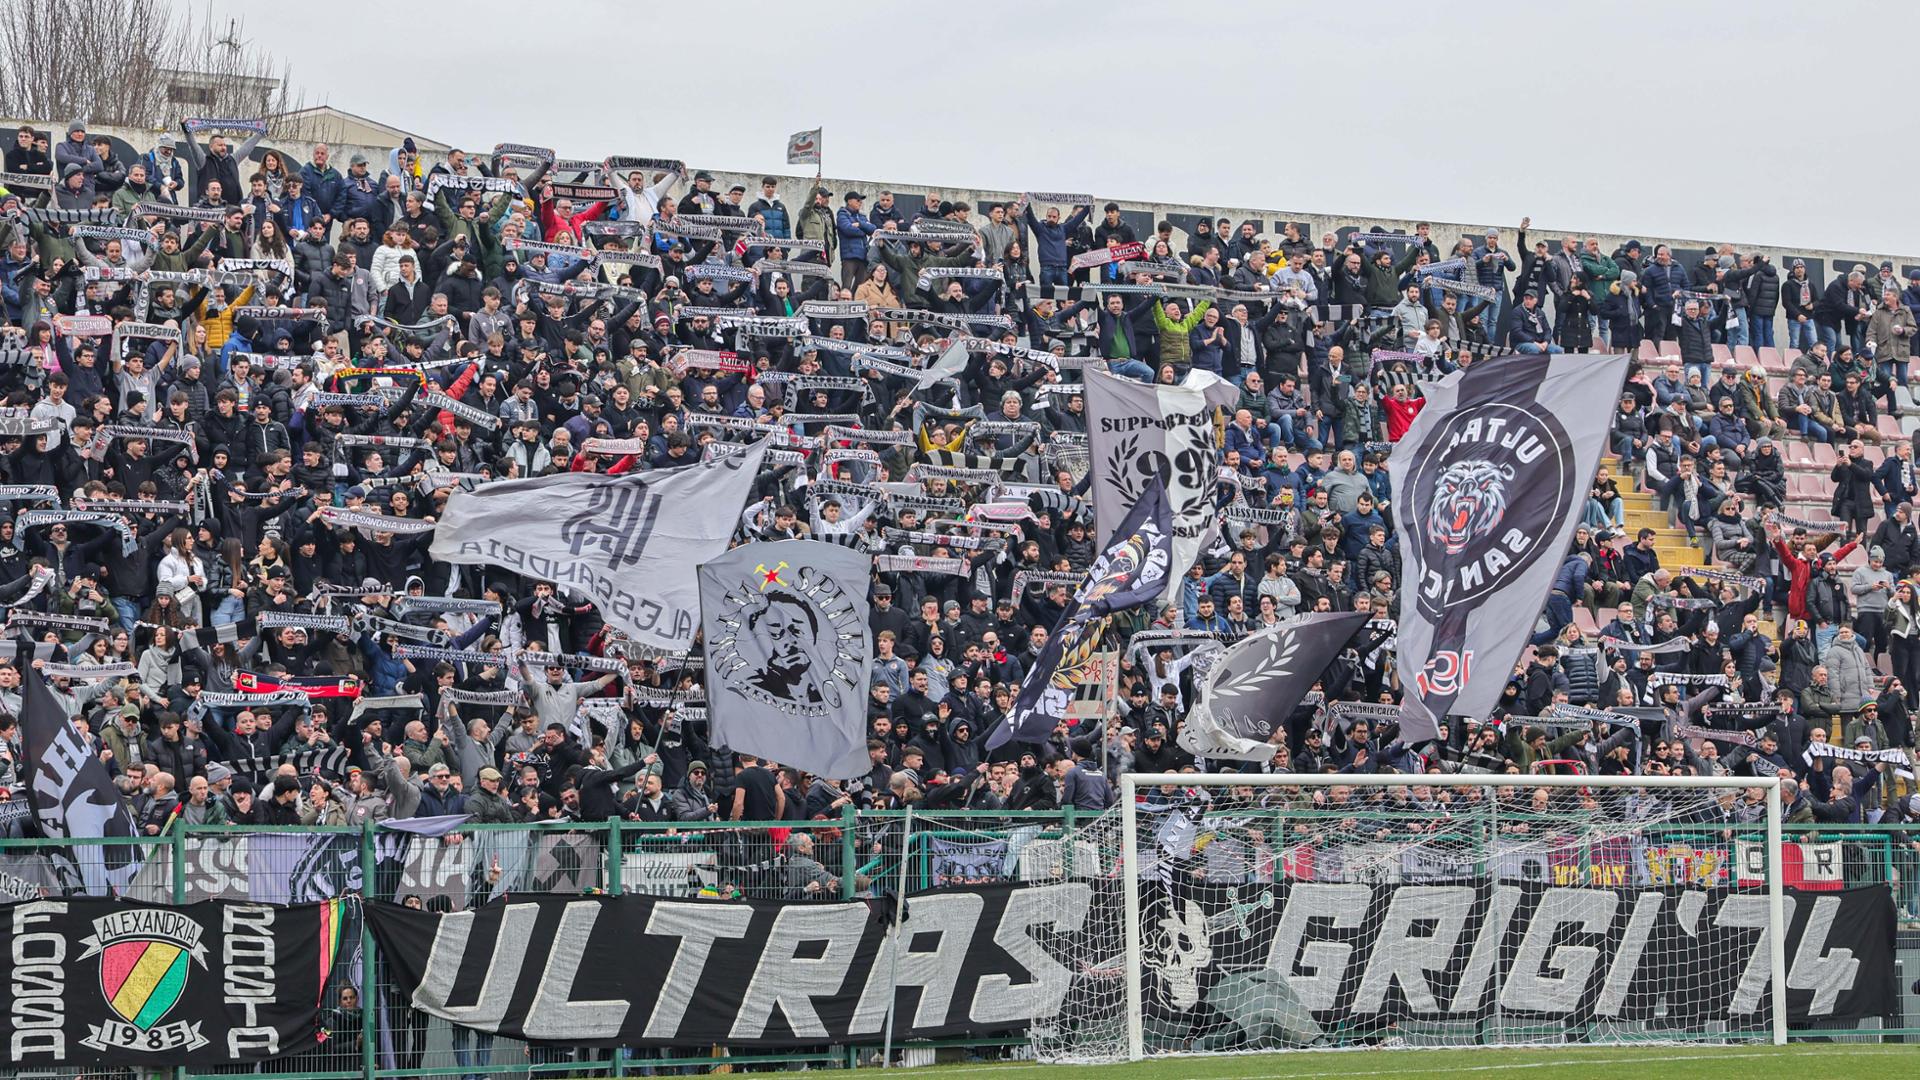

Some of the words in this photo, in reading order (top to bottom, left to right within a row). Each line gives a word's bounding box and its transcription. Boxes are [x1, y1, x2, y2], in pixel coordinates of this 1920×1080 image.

[619, 158, 655, 170] ALESSANDRIA
[23, 174, 52, 188] LTRAS
[554, 186, 574, 197] FORZA
[575, 188, 616, 199] ALESSANDRIA
[82, 225, 116, 236] FORZA
[119, 229, 148, 240] GRIGI
[1113, 246, 1143, 256] MILAN
[699, 266, 728, 276] FORZA
[119, 322, 152, 336] ULTRAS
[816, 338, 848, 351] viaggio
[319, 394, 353, 403] FORZA
[22, 510, 64, 526] viaggio
[340, 511, 403, 529] ALESSANDRIA
[1225, 507, 1288, 522] ALESSANDRIA
[516, 651, 556, 664] ORZA
[203, 692, 249, 706] viaggio
[1332, 703, 1375, 717] ALESSANDRIA
[1814, 848, 1834, 876] R
[643, 860, 688, 880] Ultras
[102, 912, 198, 944] ALEXANDRIA
[1265, 883, 1665, 1016] GRIGI
[411, 882, 1092, 1041] ULTRAS
[11, 902, 69, 1062] FOSSA
[222, 903, 280, 1059] RASTA
[110, 1021, 187, 1049] 1985
